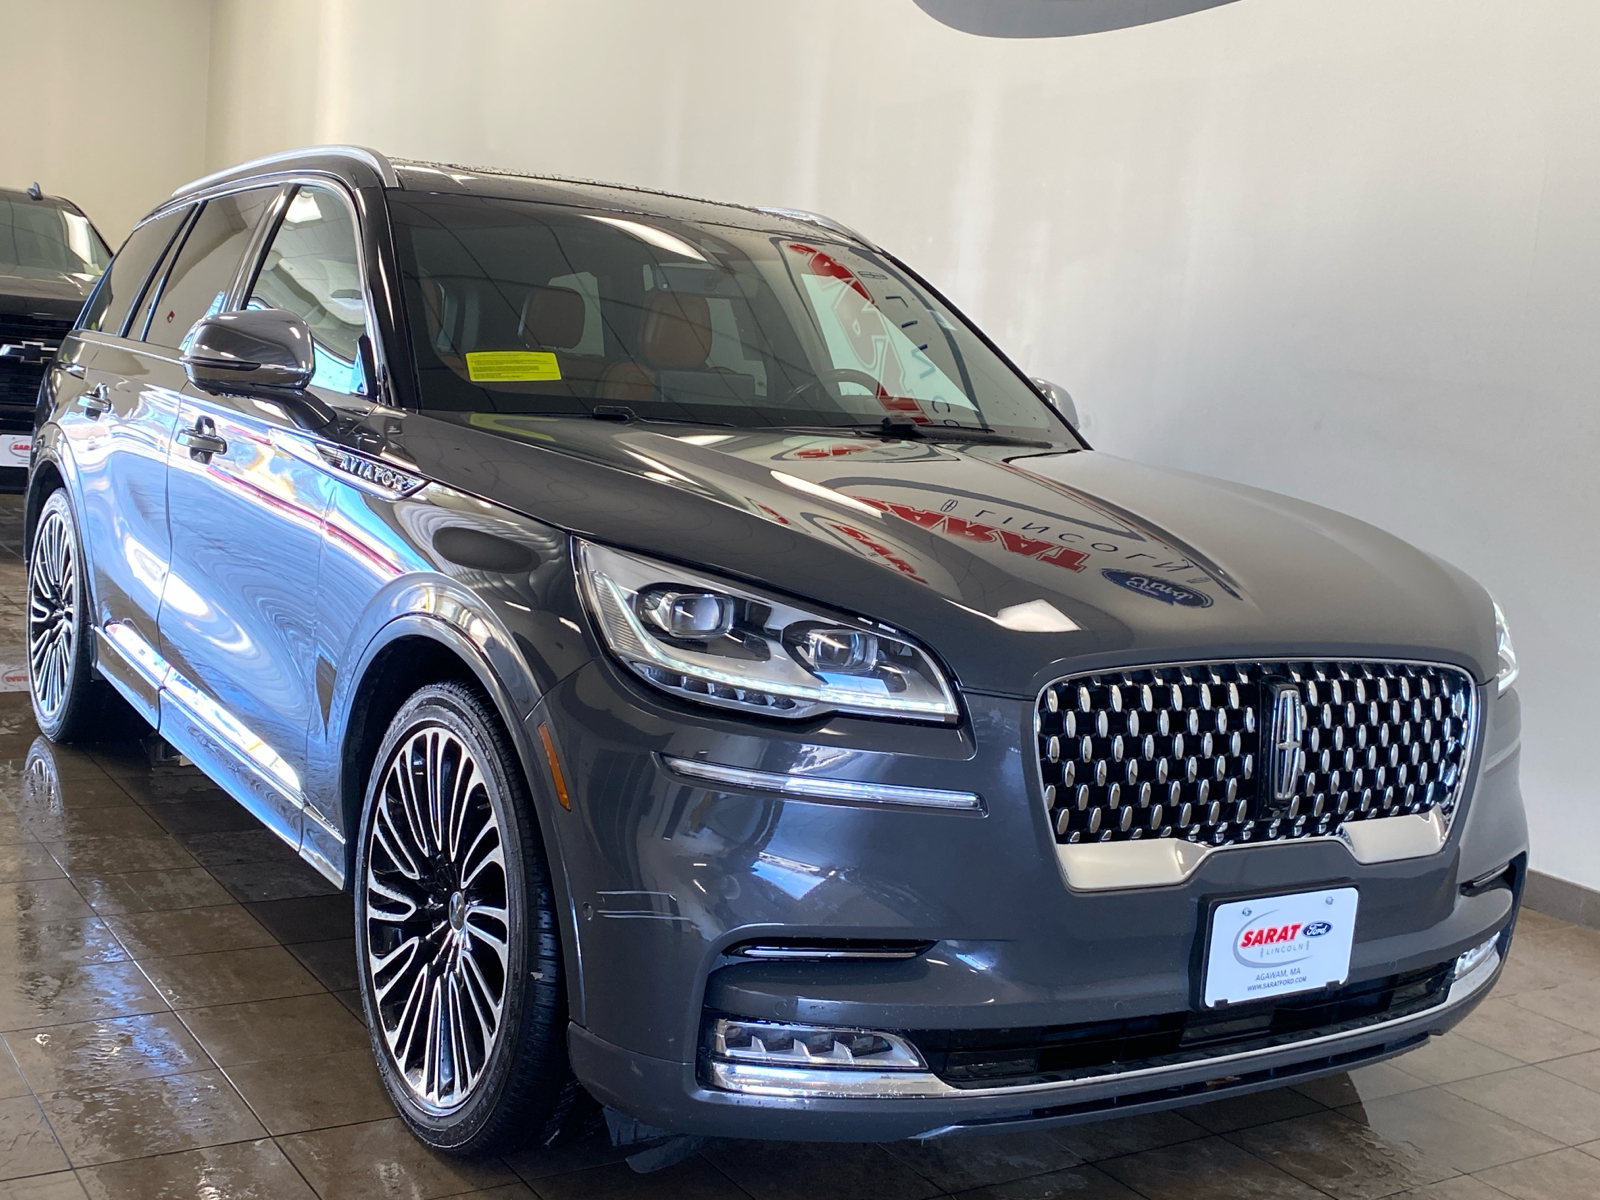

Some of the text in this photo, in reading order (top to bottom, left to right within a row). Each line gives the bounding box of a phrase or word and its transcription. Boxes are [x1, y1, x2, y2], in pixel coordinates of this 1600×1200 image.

[340, 456, 403, 490] AVIATOR
[1240, 922, 1330, 948] SARAT Ford
[1266, 943, 1303, 955] LINCOLN
[1255, 967, 1301, 981] AGAWAM, MA
[1247, 976, 1307, 991] WWW.SARATFORD.COM
